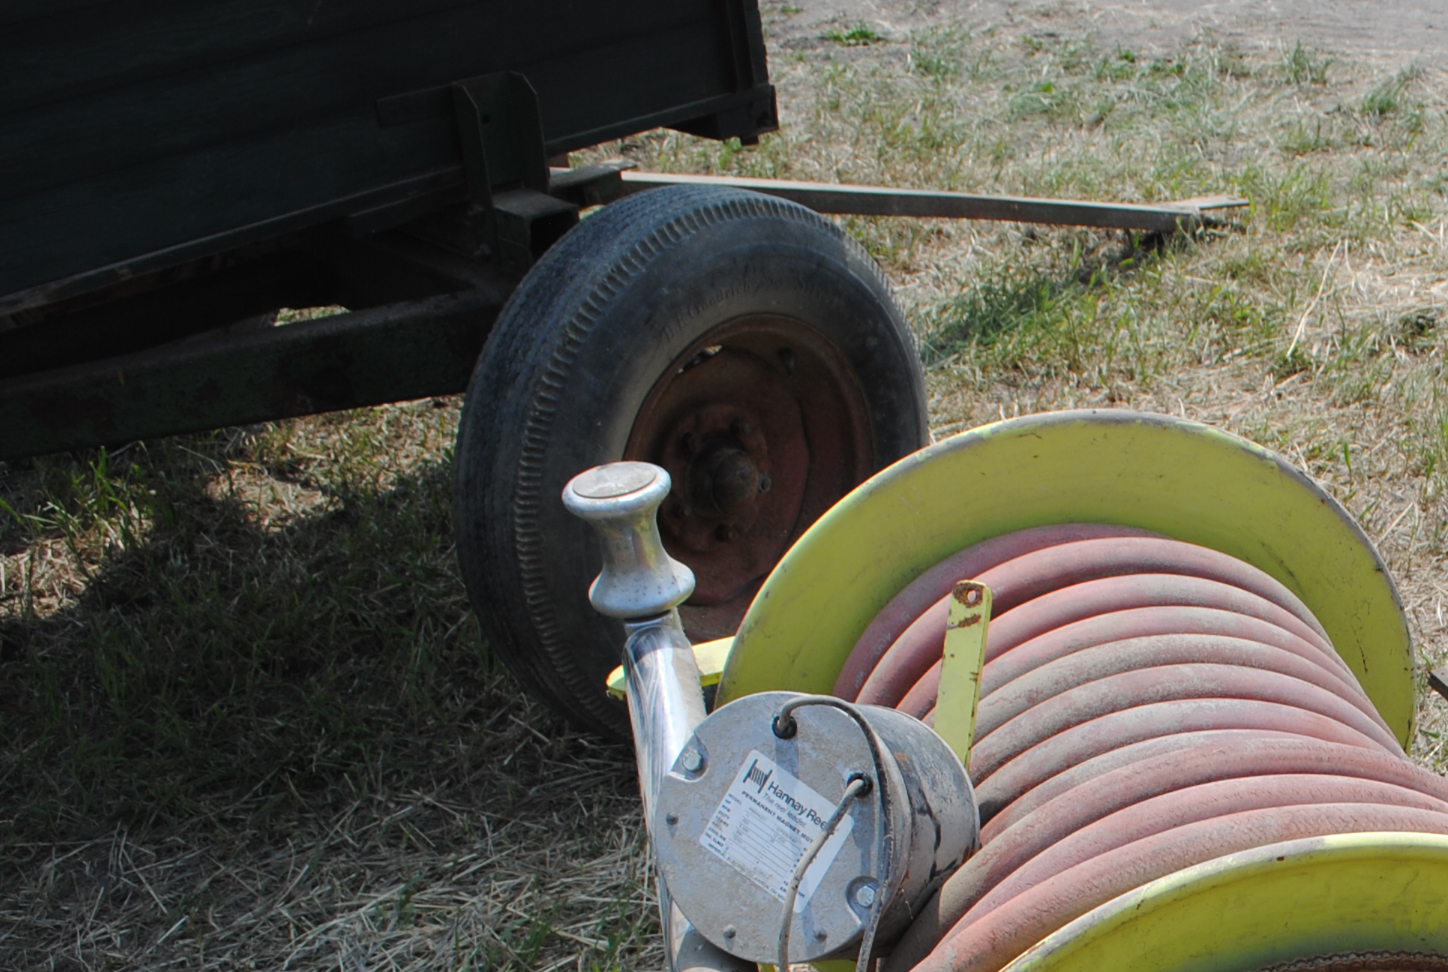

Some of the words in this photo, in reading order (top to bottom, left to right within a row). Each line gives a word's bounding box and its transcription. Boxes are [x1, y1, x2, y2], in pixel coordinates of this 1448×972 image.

[742, 790, 777, 816] PERMANENT
[776, 815, 801, 834] MAGNET
[768, 781, 807, 815] Hannay
[807, 809, 829, 831] Ree
